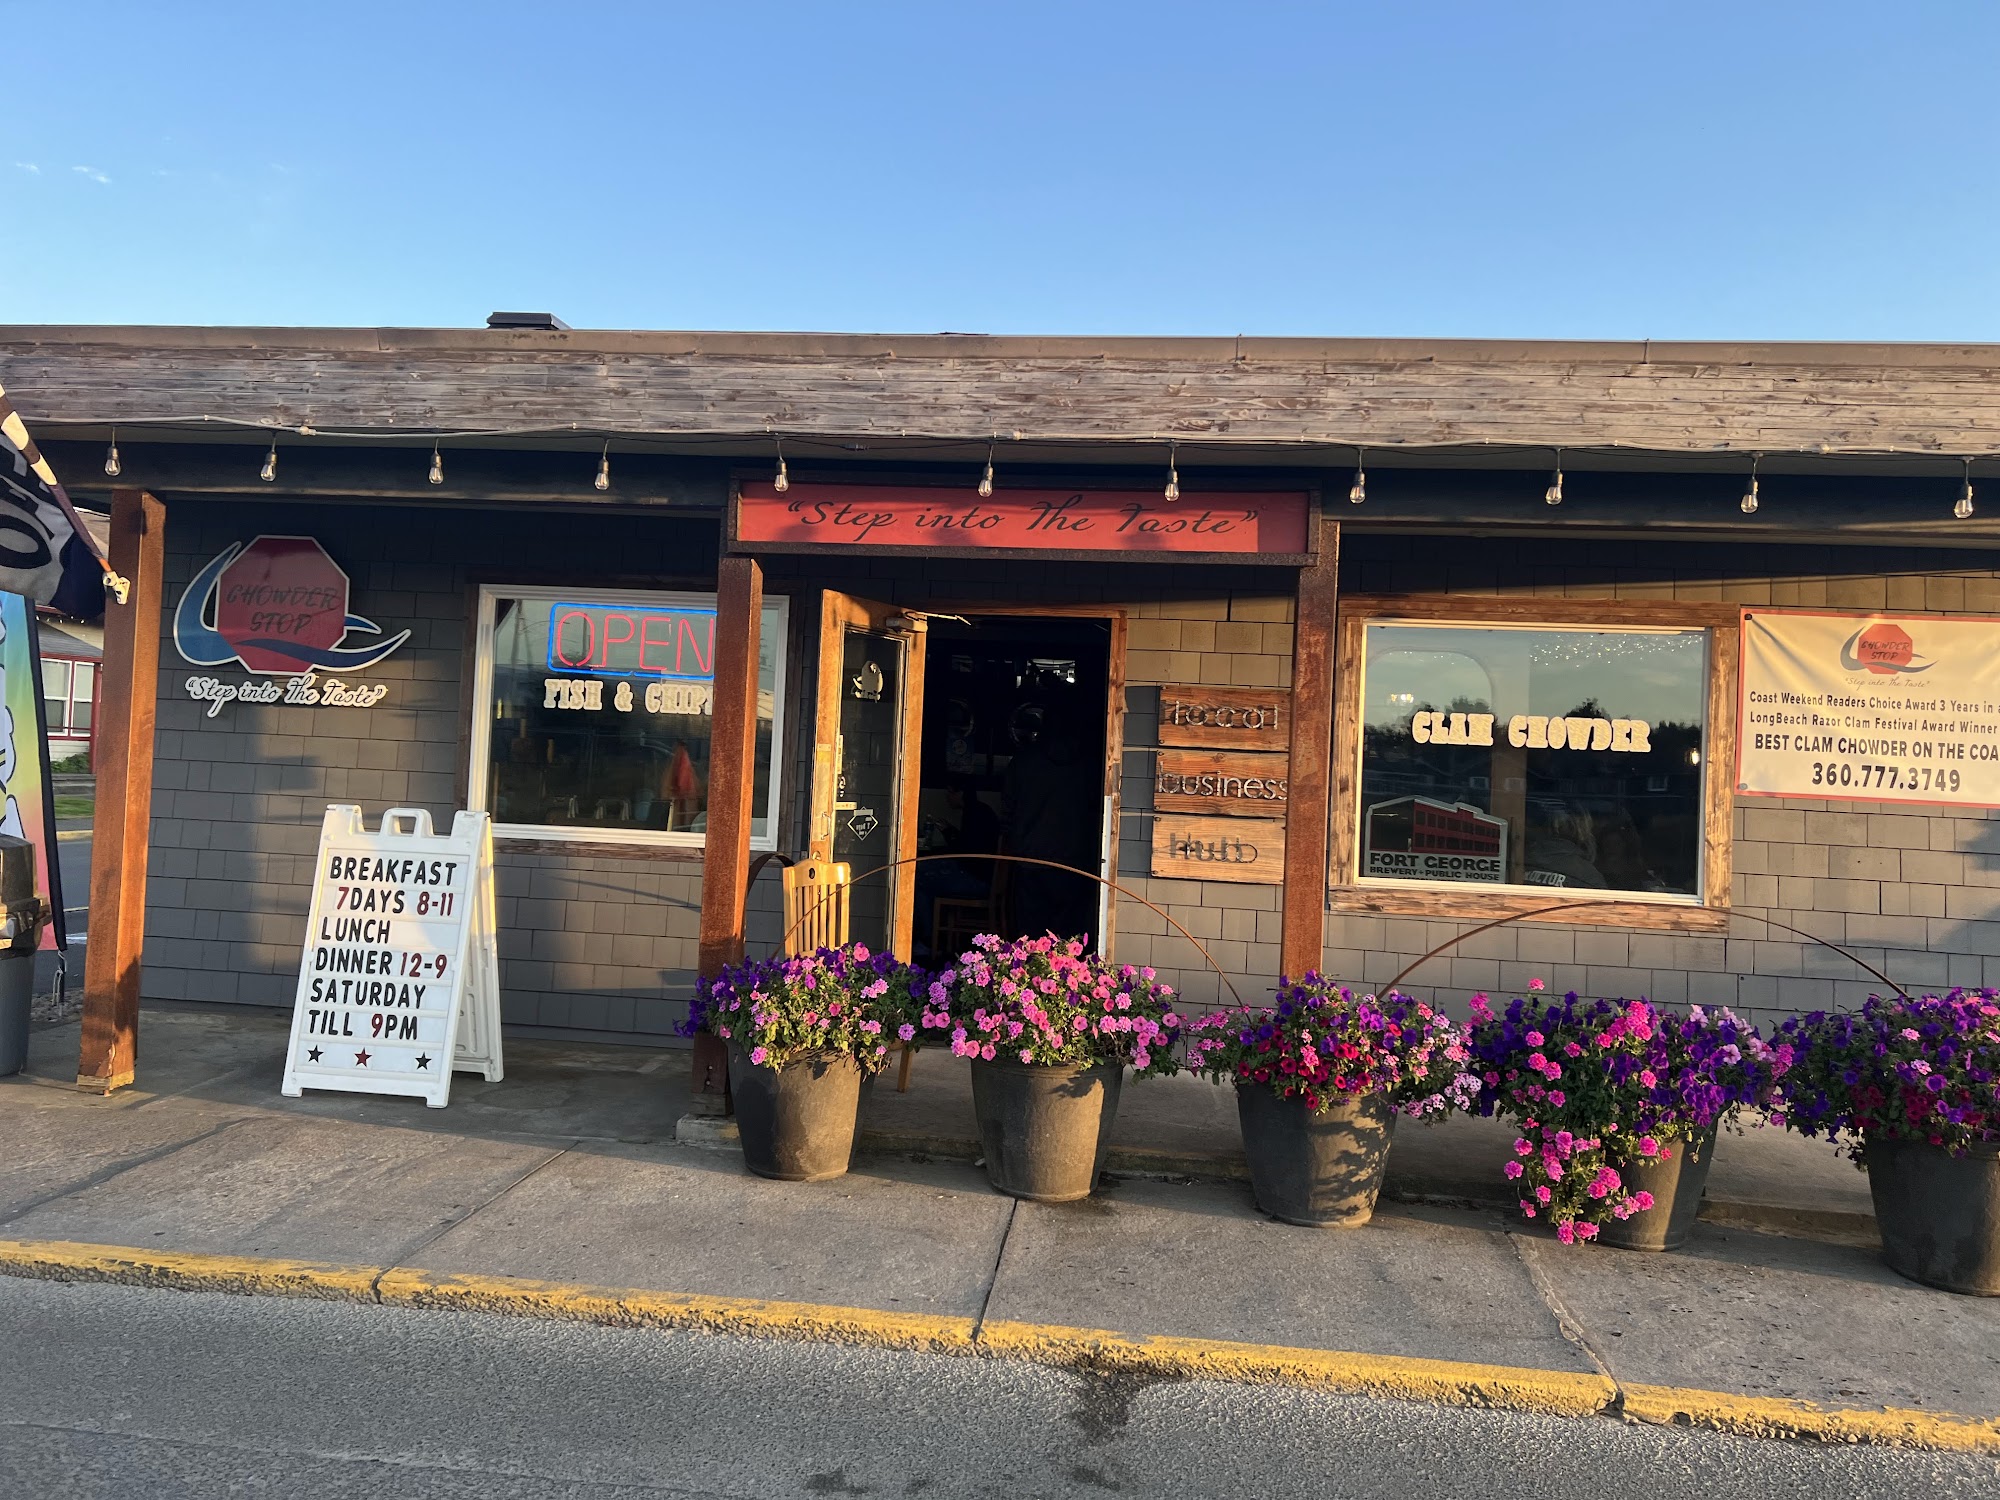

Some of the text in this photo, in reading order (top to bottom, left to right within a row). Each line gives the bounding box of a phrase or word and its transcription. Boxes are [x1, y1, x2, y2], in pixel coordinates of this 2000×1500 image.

[915, 506, 1005, 529] into
[1026, 494, 1095, 531] The
[226, 584, 341, 610] CHOWDER
[250, 611, 312, 635] STOP
[556, 611, 715, 673] OPEN
[1860, 640, 1910, 652] CHOWDER
[1871, 651, 1899, 661] STOP
[238, 680, 282, 703] into
[284, 673, 320, 704] The
[543, 678, 604, 711] FISH
[614, 681, 634, 712] &
[1867, 678, 1886, 686] into
[1888, 676, 1901, 687] The
[1174, 700, 1279, 730] local
[1749, 691, 1778, 704] Coast
[1781, 691, 1824, 706] Weekend
[1826, 694, 1866, 708] Readers
[1869, 696, 1902, 710] Choice
[1905, 698, 1937, 711] Award
[1939, 699, 1946, 712] 3
[1950, 700, 1980, 713] Years
[1983, 700, 1994, 714] in
[1411, 711, 1652, 753] CLAM CHOWDER
[1812, 713, 1841, 726] Razor
[1844, 715, 1871, 729] Clam
[1875, 716, 1918, 731] Festival
[1921, 718, 1955, 733] Award
[1959, 720, 1998, 735] Winner
[1755, 733, 1790, 751] BEST
[1794, 735, 1833, 753] CLAM
[1838, 737, 1908, 757] CHOWDER
[1912, 740, 1933, 759] ON
[1937, 742, 1965, 760] THE
[1157, 761, 1288, 801] business
[1811, 762, 1962, 792] 360.777.3749
[329, 856, 457, 886] BREAKFAST
[1369, 852, 1501, 873] FORT GEORGE
[1369, 866, 1418, 876] BREWERY
[1425, 869, 1462, 879] PUBLIC
[1465, 871, 1501, 881] HOUSE
[416, 891, 454, 917] 8-11
[321, 916, 391, 944] LUNCH
[315, 947, 448, 979] DINNER 12-9
[310, 978, 426, 1009] SATURDAY
[308, 1009, 418, 1041] TILL 9PM
